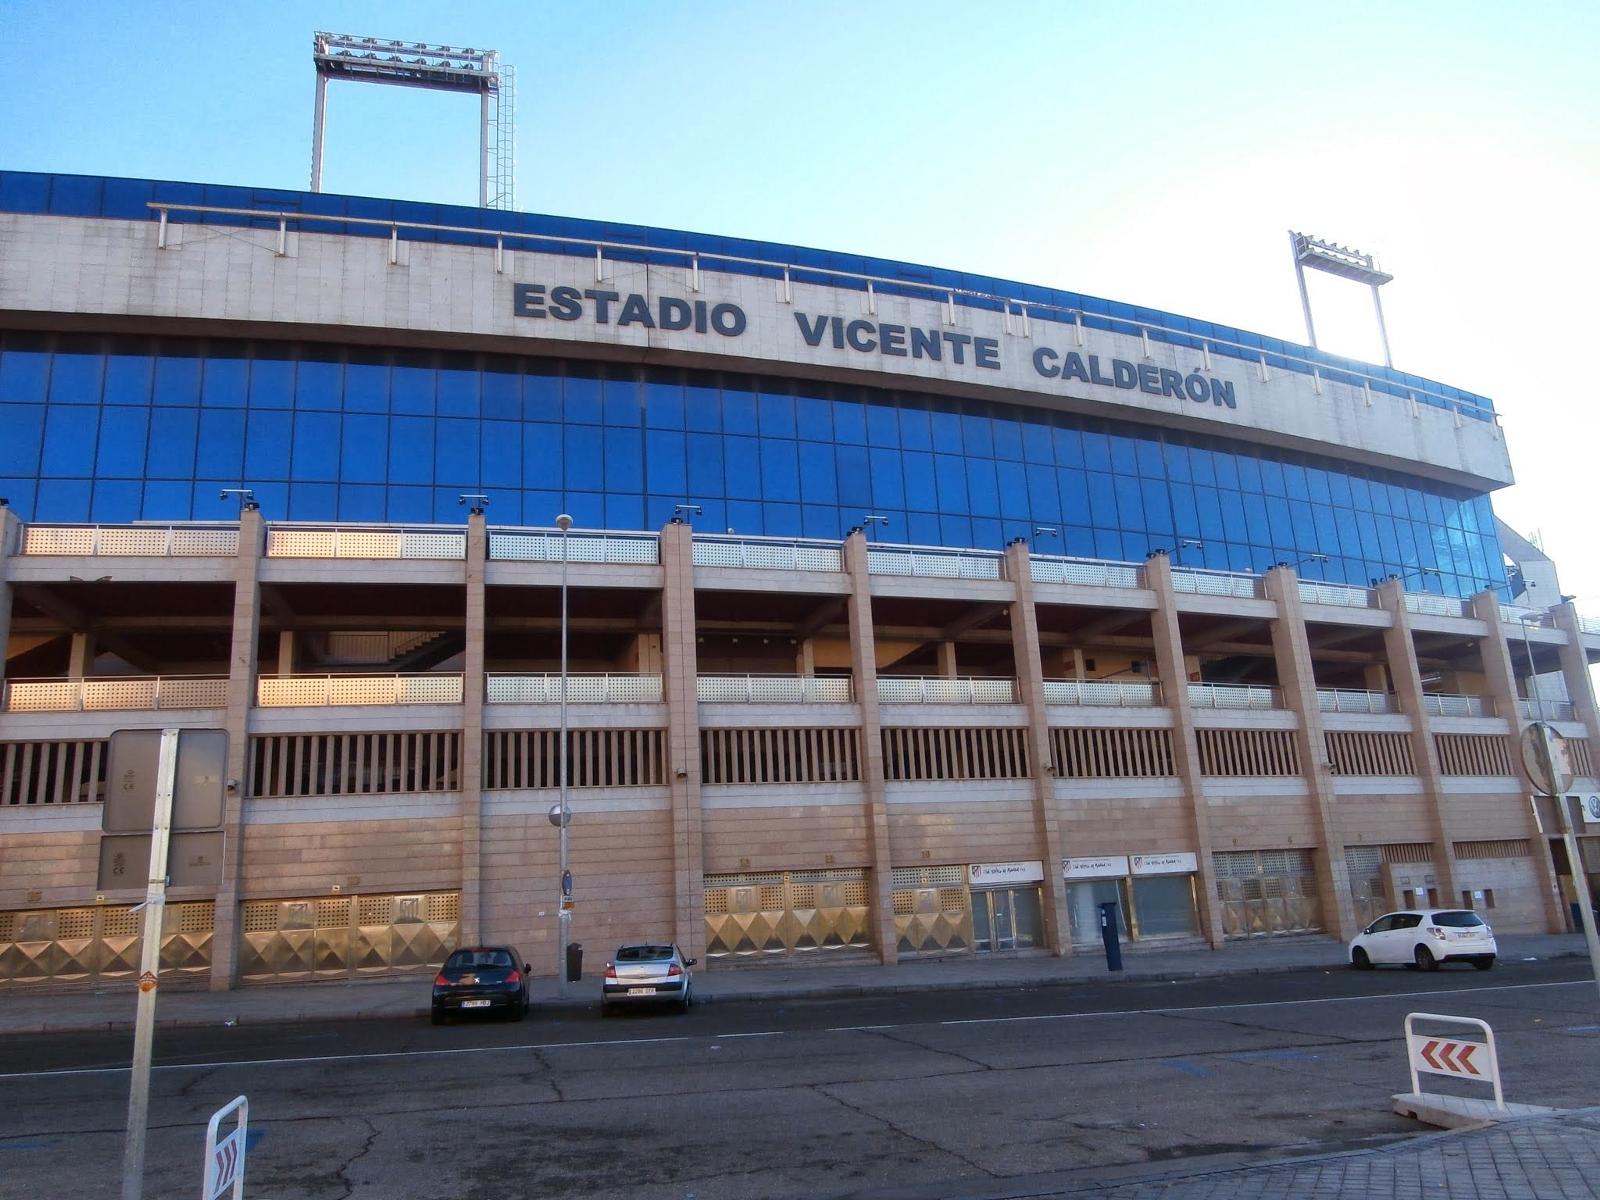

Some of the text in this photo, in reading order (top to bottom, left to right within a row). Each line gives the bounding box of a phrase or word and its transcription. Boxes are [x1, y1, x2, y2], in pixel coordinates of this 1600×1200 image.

[514, 282, 1237, 409] ESTADIO VICENTE CALDERÓN
